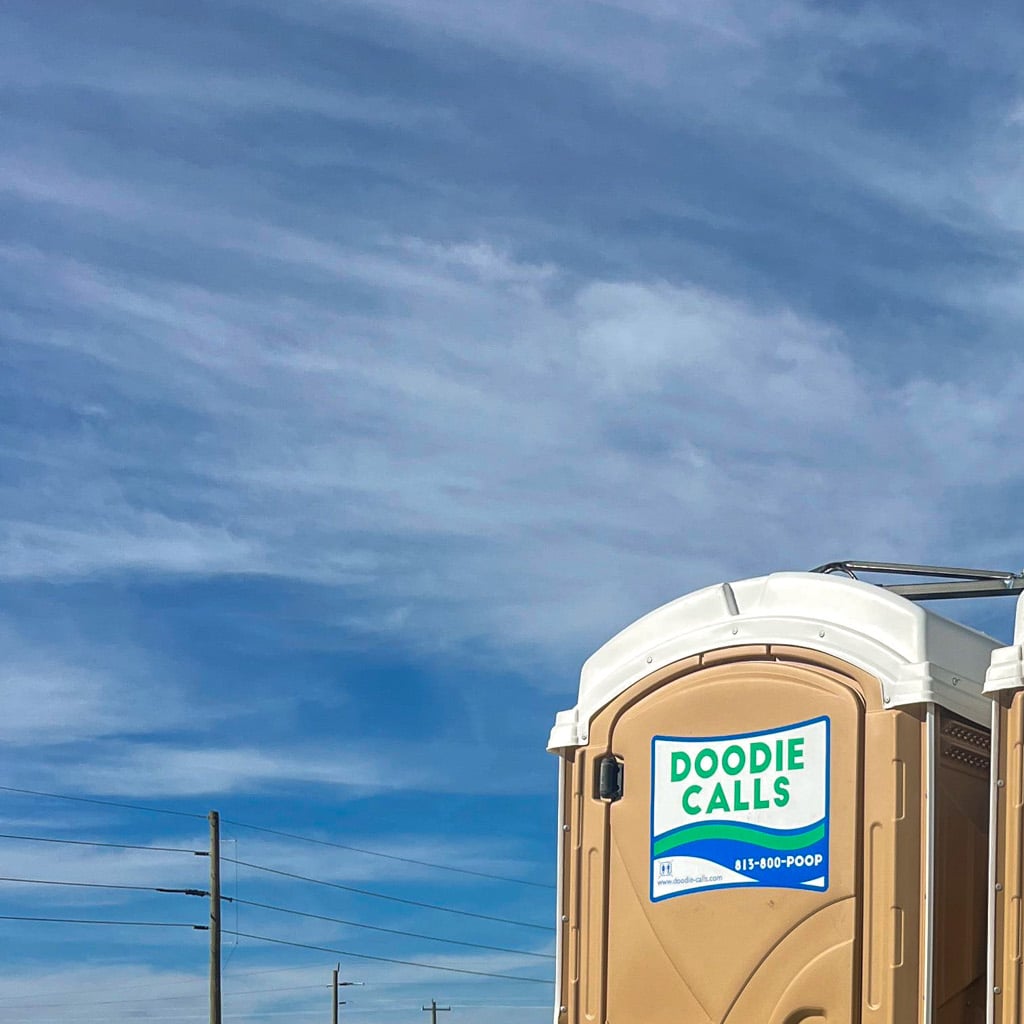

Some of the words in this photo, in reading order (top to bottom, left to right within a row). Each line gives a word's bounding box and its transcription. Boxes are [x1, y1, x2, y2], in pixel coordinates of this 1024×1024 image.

[670, 737, 805, 782] DOODIE
[682, 776, 790, 815] CALLS
[734, 854, 823, 871] 813-800-POOP
[657, 874, 723, 886] www.doodie-calls.com
